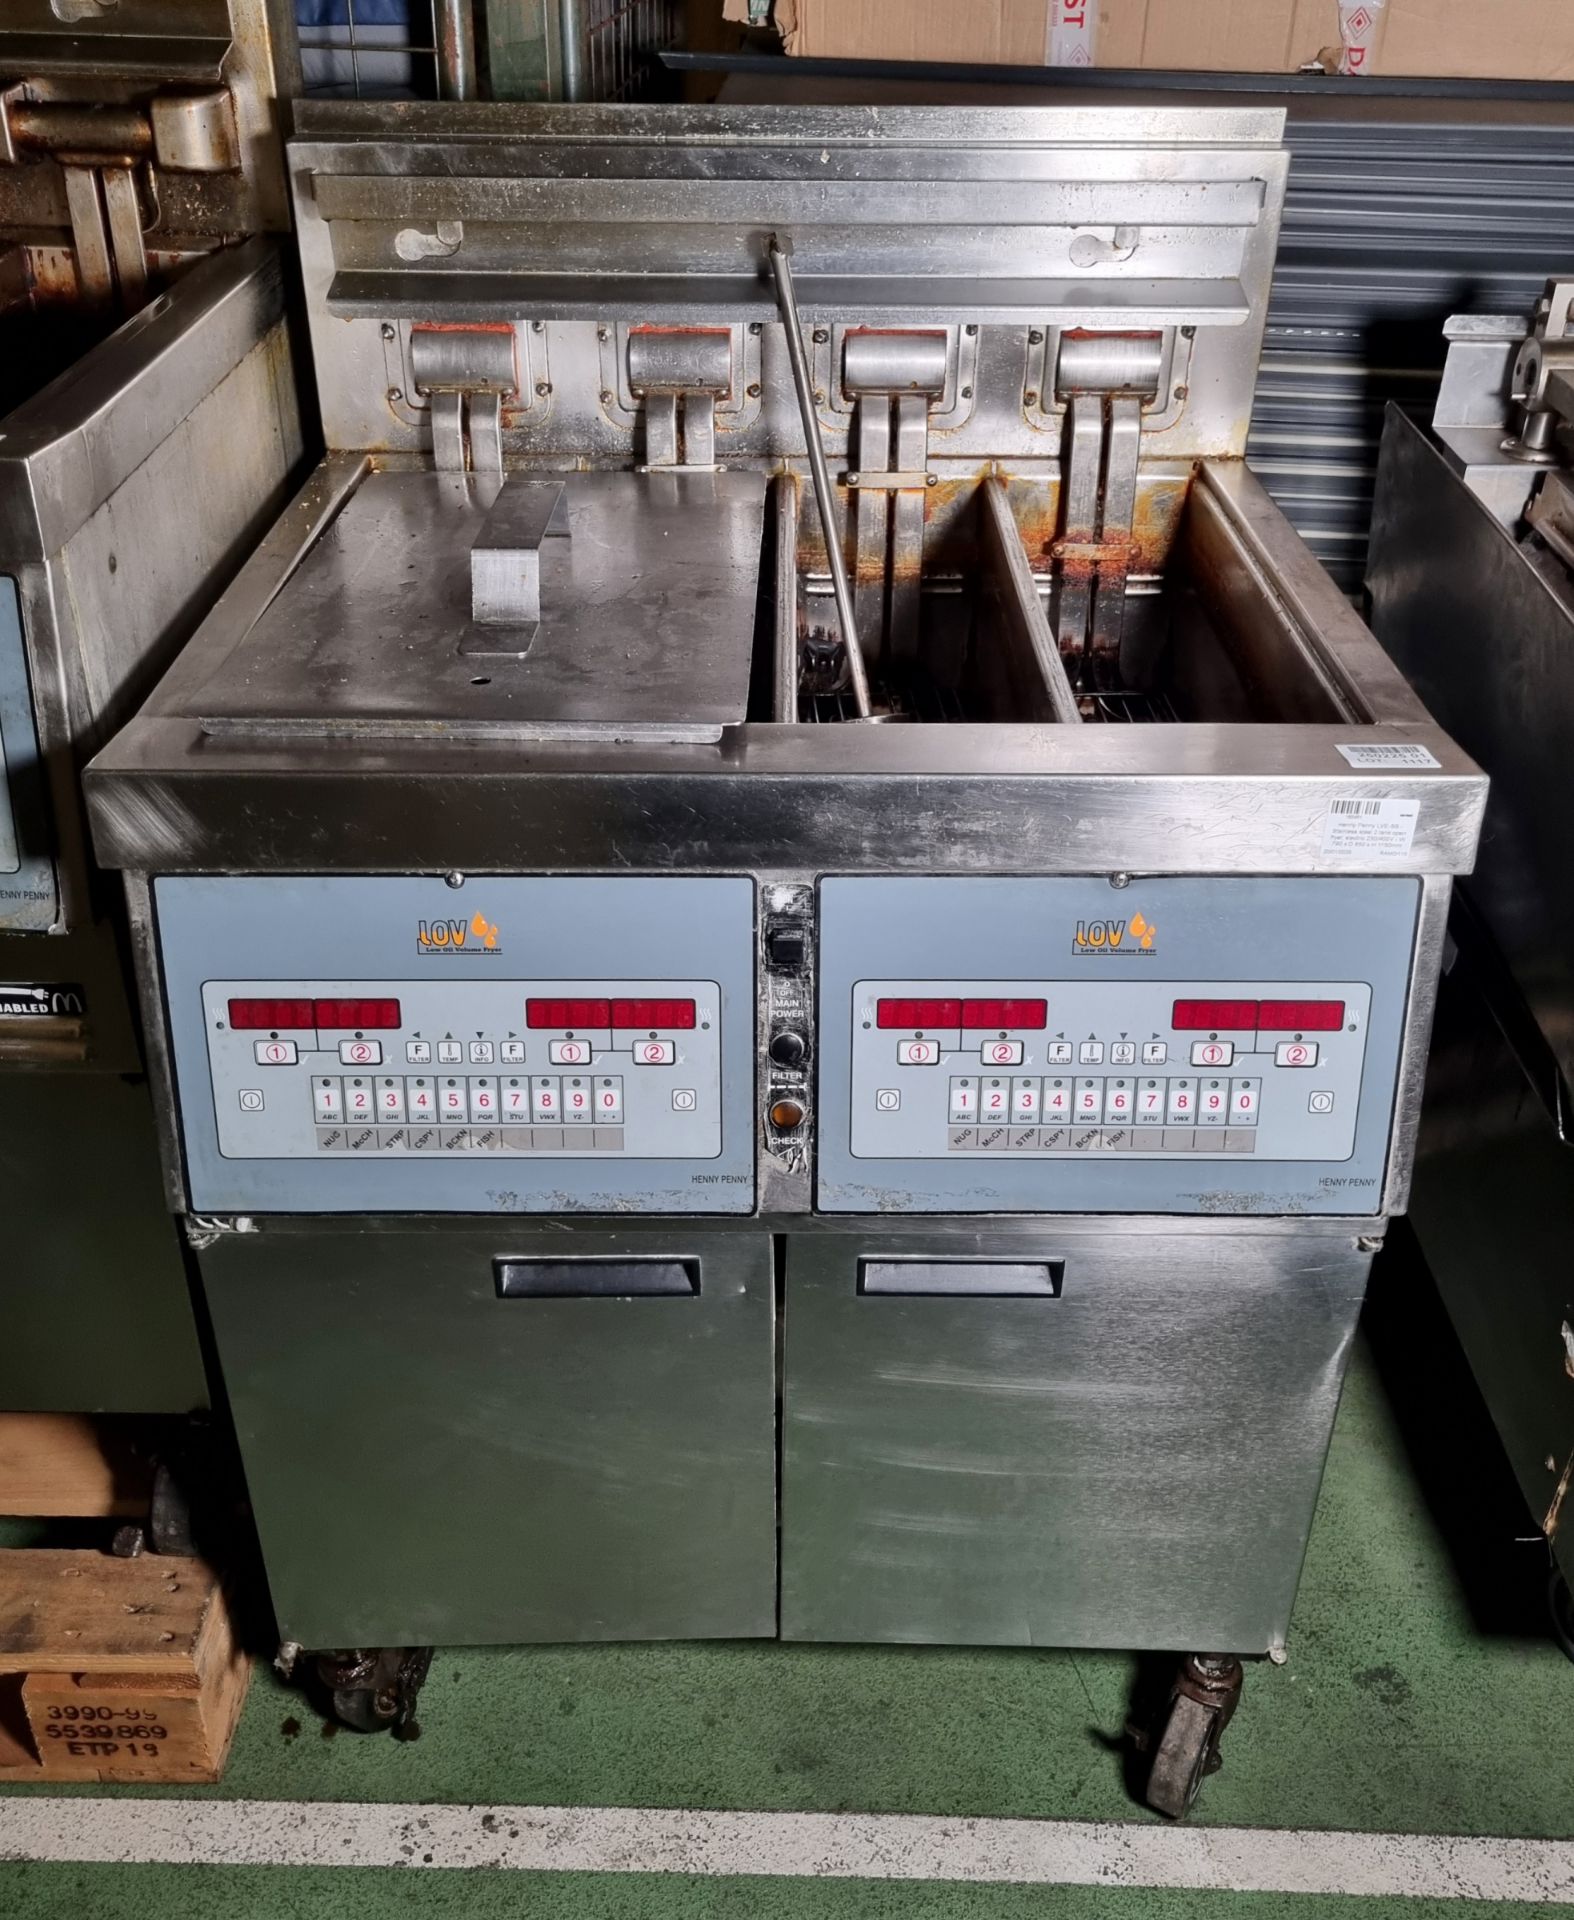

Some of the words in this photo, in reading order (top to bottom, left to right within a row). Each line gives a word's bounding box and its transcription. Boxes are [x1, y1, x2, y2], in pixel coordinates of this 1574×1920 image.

[23, 890, 49, 900] PENNY
[418, 919, 468, 946] LOV
[1077, 920, 1126, 947] LOV
[0, 1003, 49, 1013] ABLED
[770, 1010, 804, 1018] POWER
[772, 1072, 802, 1080] FILTER
[324, 1094, 331, 1107] 1
[355, 1094, 365, 1107] 2
[386, 1094, 396, 1107] 3
[417, 1094, 427, 1107] 4
[448, 1094, 458, 1107] 5
[479, 1094, 489, 1107] 6
[510, 1094, 520, 1107] 7
[542, 1094, 551, 1107] 8
[573, 1094, 583, 1107] 9
[604, 1094, 614, 1107] 0
[961, 1094, 967, 1107] 1
[991, 1094, 1001, 1107] 2
[1022, 1094, 1032, 1107] 3
[1053, 1094, 1062, 1107] 4
[1084, 1094, 1094, 1107] 5
[1115, 1095, 1125, 1108] 6
[1147, 1095, 1156, 1108] 7
[1177, 1095, 1187, 1108] 8
[1209, 1095, 1219, 1108] 9
[1240, 1095, 1250, 1108] 0
[323, 1130, 341, 1148] NUG
[352, 1129, 373, 1150] McCH
[385, 1129, 404, 1149] STRP
[414, 1129, 434, 1149] CSPY
[446, 1128, 468, 1150] BCKN
[476, 1130, 495, 1148] FISH
[771, 1137, 803, 1145] CHECK
[954, 1128, 972, 1145] NUG
[982, 1128, 1005, 1148] McCH
[1015, 1128, 1036, 1148] STRP
[1043, 1128, 1066, 1148] CSPY
[1075, 1128, 1099, 1149] BCKN
[1106, 1130, 1126, 1147] FISH
[691, 1175, 719, 1184] HENNY
[721, 1175, 748, 1184] PENNY
[1318, 1177, 1348, 1186] HENNY
[1348, 1178, 1377, 1187] PENNY
[67, 1742, 119, 1756] ETP
